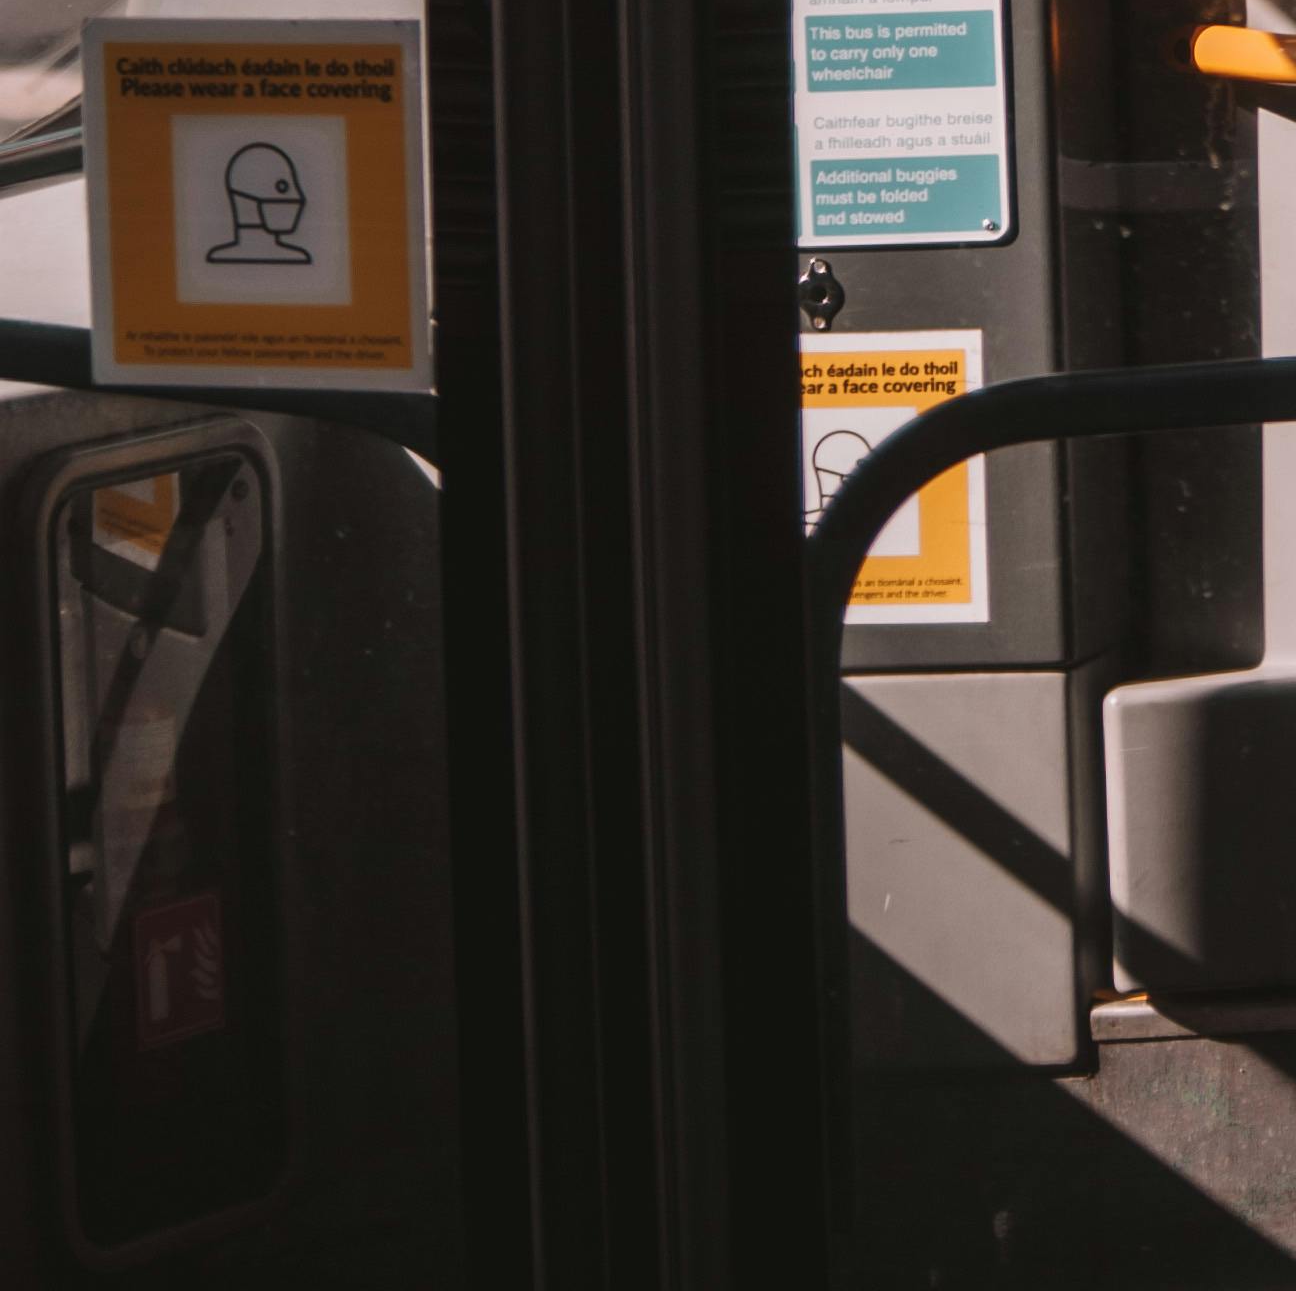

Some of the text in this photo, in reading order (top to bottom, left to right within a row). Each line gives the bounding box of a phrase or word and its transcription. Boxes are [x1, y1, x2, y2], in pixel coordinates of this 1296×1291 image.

[809, 21, 968, 41] This bus is permitted
[811, 45, 939, 63] to carry only one
[116, 57, 163, 77] Caith
[305, 59, 321, 77] le
[325, 60, 349, 77] do
[353, 59, 395, 78] thoil
[812, 65, 894, 82] wheelchair
[121, 79, 393, 102] Please wear a face covering
[814, 112, 993, 130] Caithfear bugithe breise
[814, 140, 824, 150] a
[896, 136, 933, 150] agus
[938, 136, 947, 146] a
[816, 167, 958, 185] Additional buggies
[816, 188, 929, 206] must be folded
[817, 209, 905, 226] and stowed
[827, 363, 878, 377] éadain
[882, 362, 895, 376] le
[899, 362, 919, 376] do
[924, 361, 958, 376] thoil
[801, 378, 957, 396] ear a face covering
